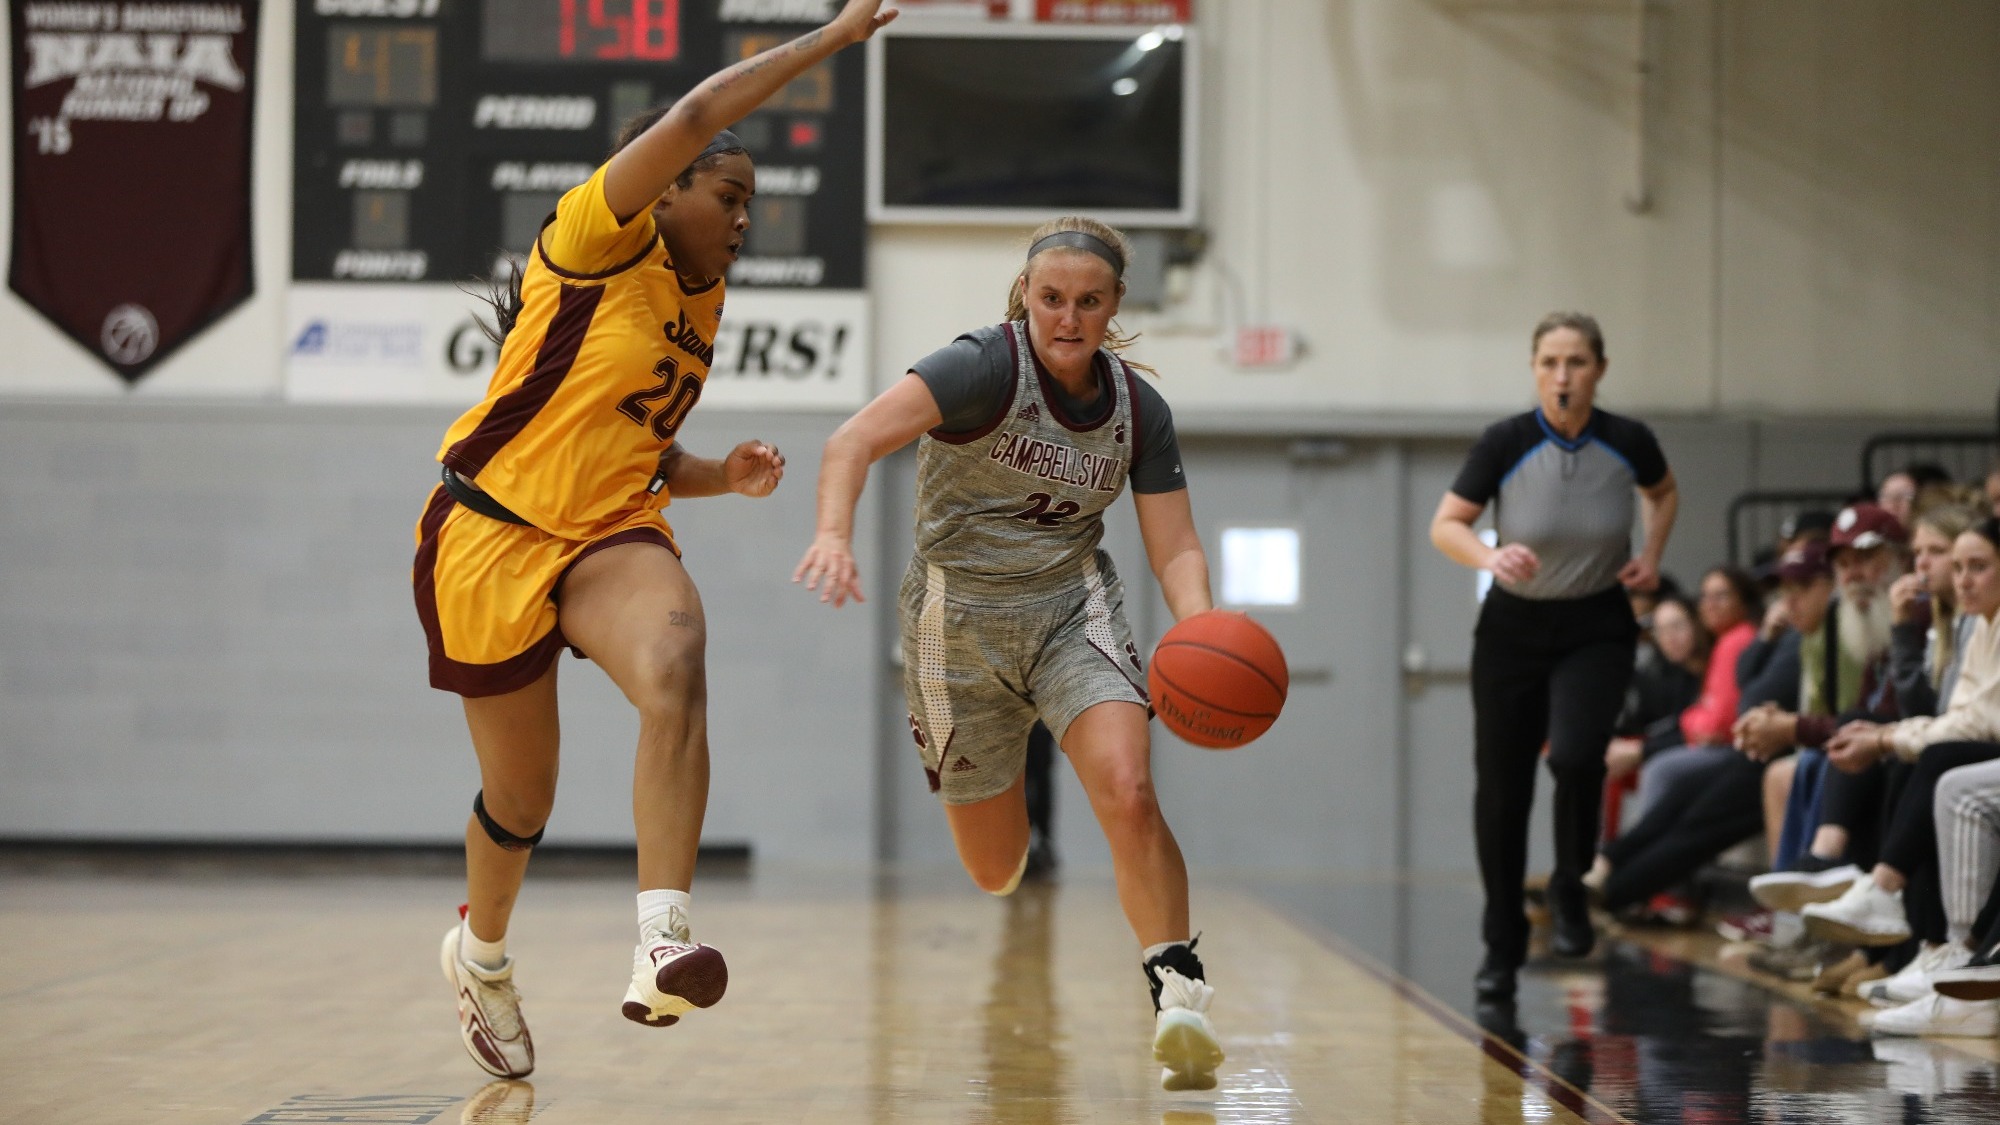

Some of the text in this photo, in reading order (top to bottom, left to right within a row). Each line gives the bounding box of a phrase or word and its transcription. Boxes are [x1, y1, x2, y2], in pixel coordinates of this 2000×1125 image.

[25, 33, 245, 91] NAIA
[473, 95, 597, 129] PERIOD
[339, 159, 424, 189] FOULS
[333, 250, 427, 280] POINTS
[616, 356, 701, 442] 20
[1008, 492, 1081, 528] 22
[1159, 692, 1246, 742] SPALDING
